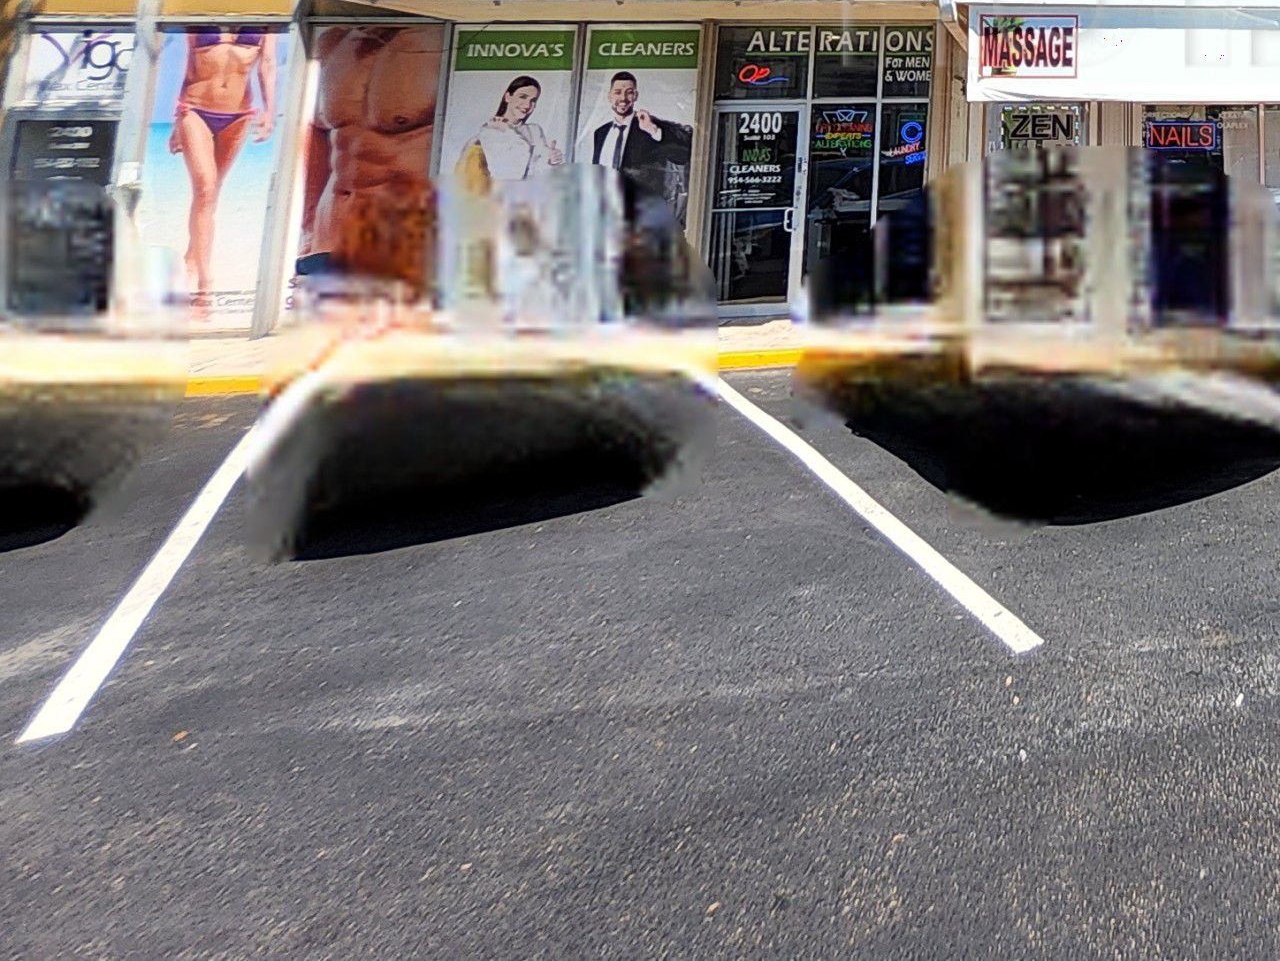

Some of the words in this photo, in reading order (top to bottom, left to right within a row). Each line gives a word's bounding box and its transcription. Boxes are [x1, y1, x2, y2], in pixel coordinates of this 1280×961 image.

[467, 43, 565, 58] INNOVA'S
[599, 42, 695, 57] CLEANERS
[747, 31, 932, 52] ALTERATIONS
[983, 27, 1073, 67] MASSAGE
[905, 56, 931, 68] MEN
[885, 69, 893, 82] &
[895, 69, 931, 82] WOME
[739, 113, 782, 133] 2400
[1011, 114, 1073, 140] ZEN
[1150, 125, 1213, 147] NAILS
[729, 164, 781, 174] CLEANERS
